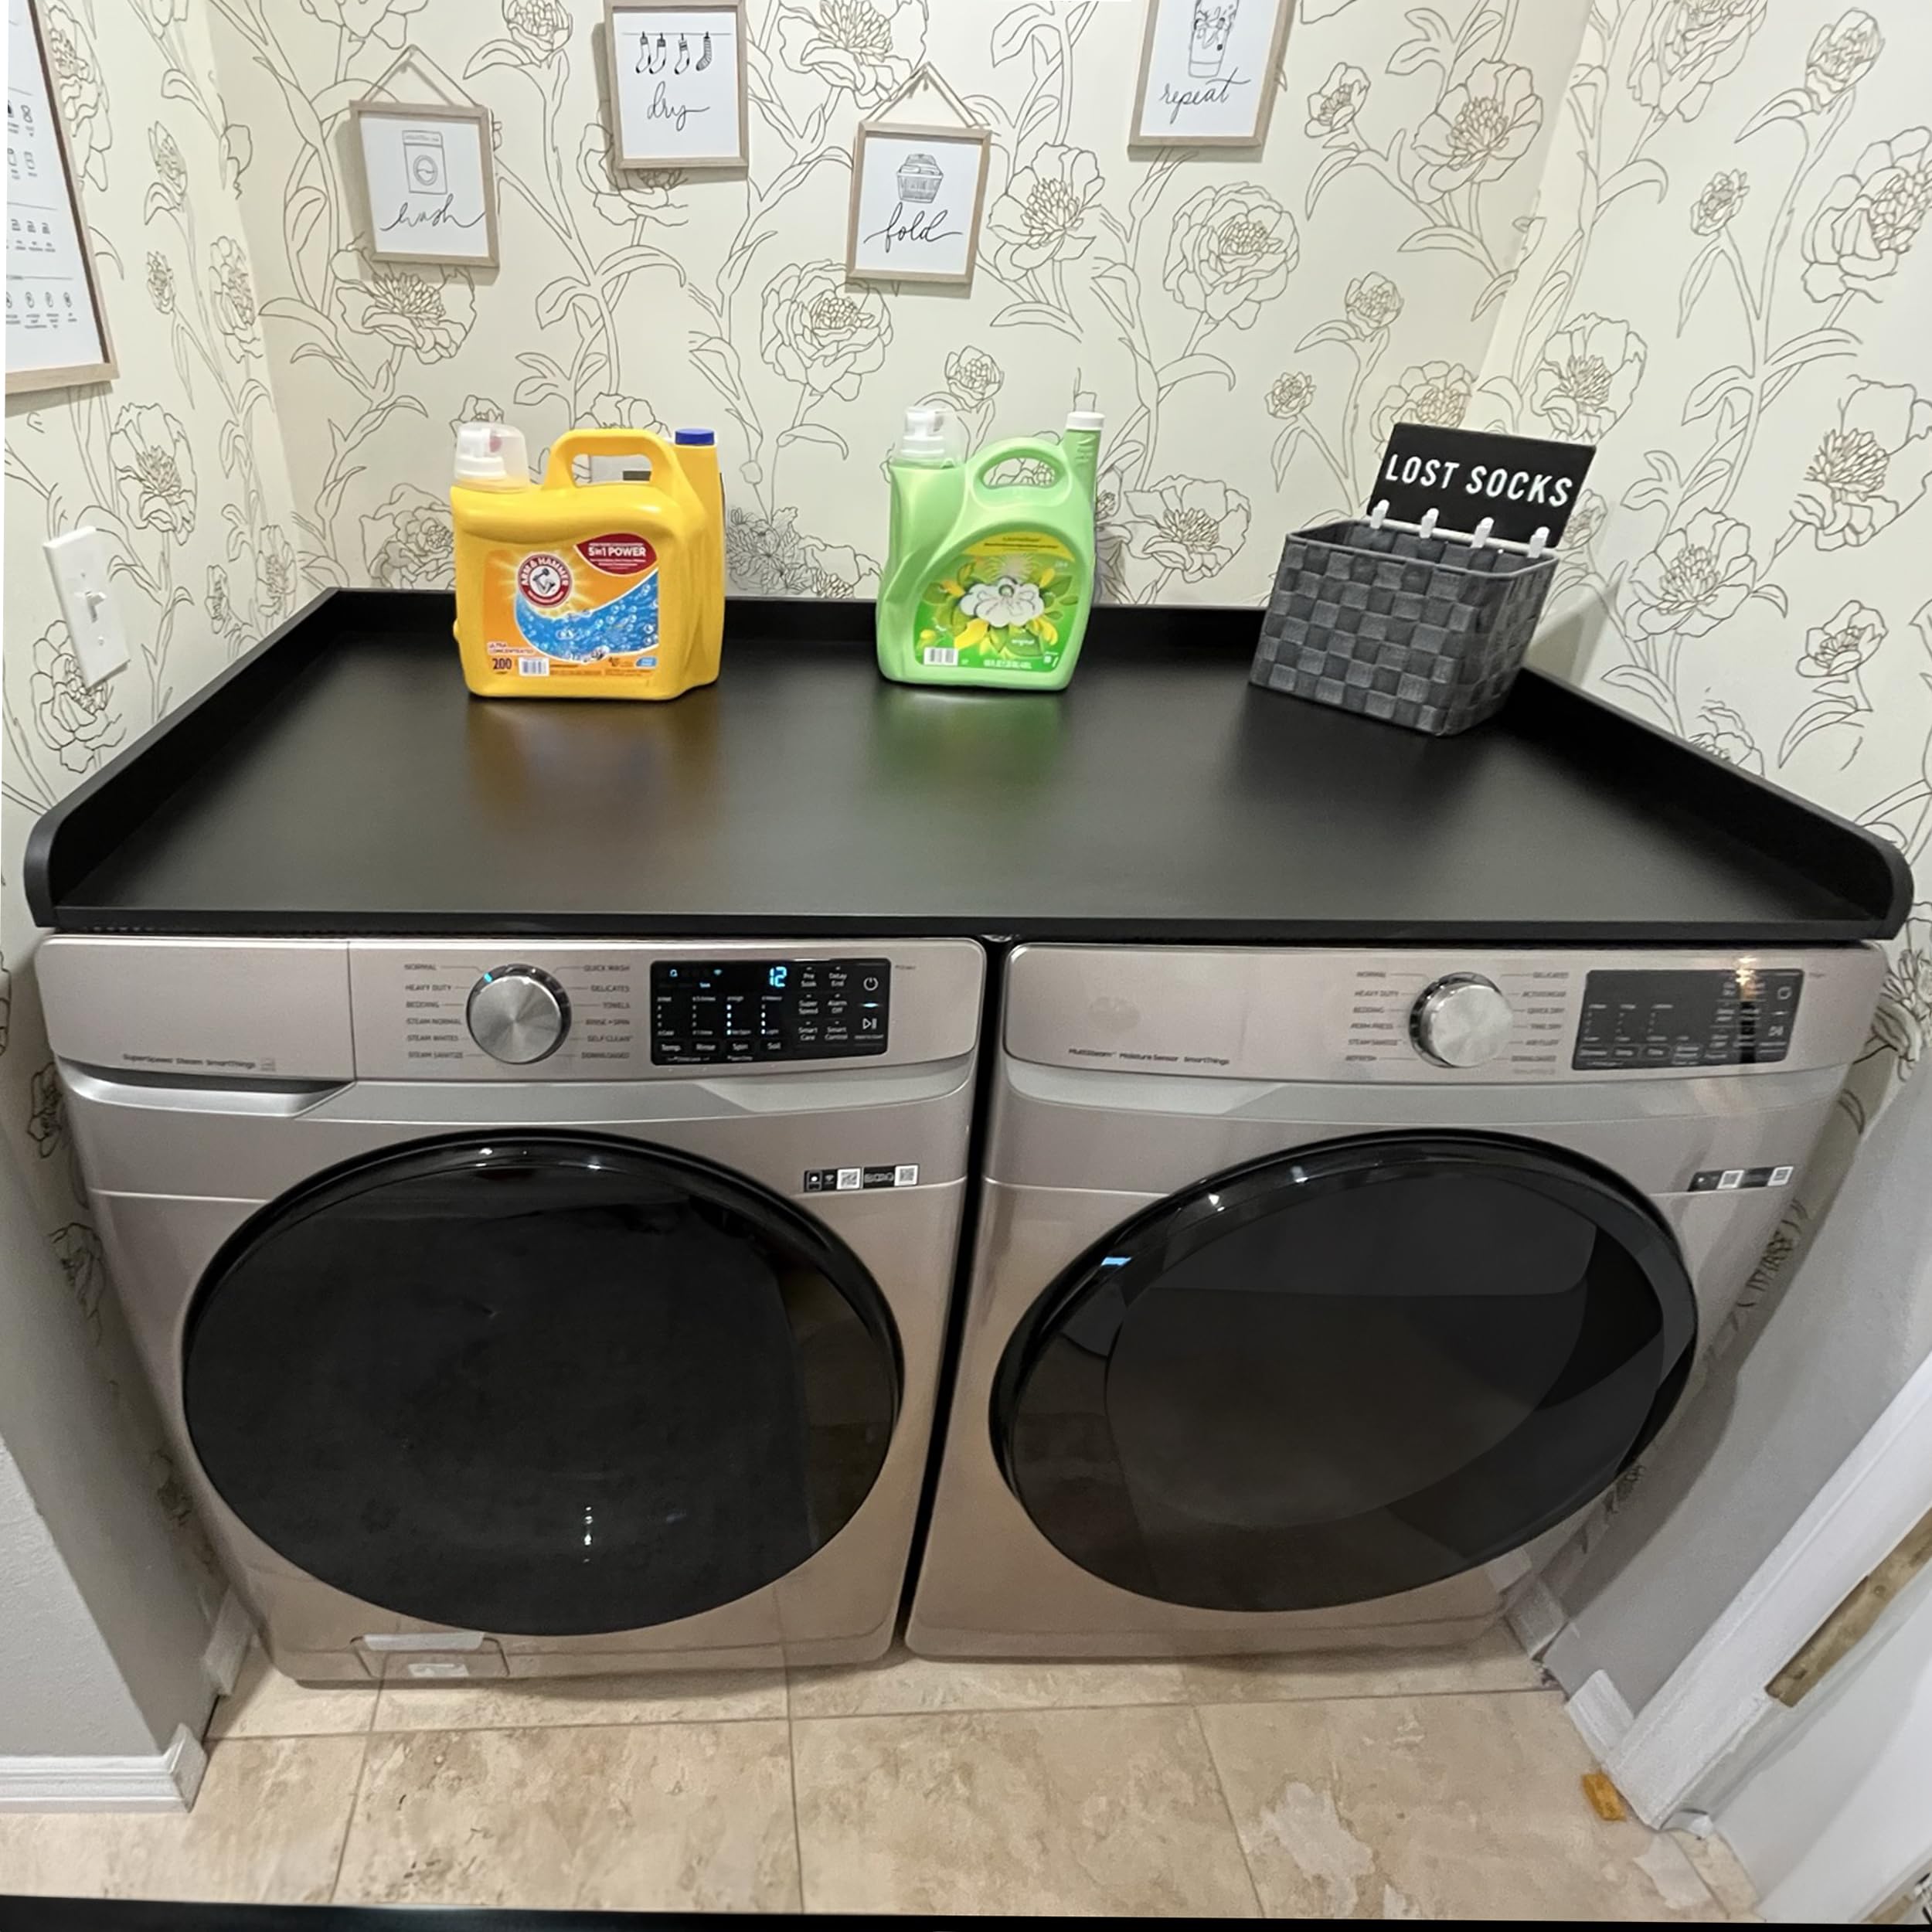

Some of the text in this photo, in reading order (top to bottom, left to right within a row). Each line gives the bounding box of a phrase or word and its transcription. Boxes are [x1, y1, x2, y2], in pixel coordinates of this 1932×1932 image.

[646, 81, 710, 131] dry
[1159, 66, 1251, 125] repeat
[379, 193, 486, 230] wash
[863, 201, 964, 253] fold
[1385, 454, 1573, 507] LOST SOCKS
[607, 546, 647, 556] POWER
[521, 565, 532, 586] ARM
[492, 658, 512, 670] 200
[769, 966, 787, 988] 12
